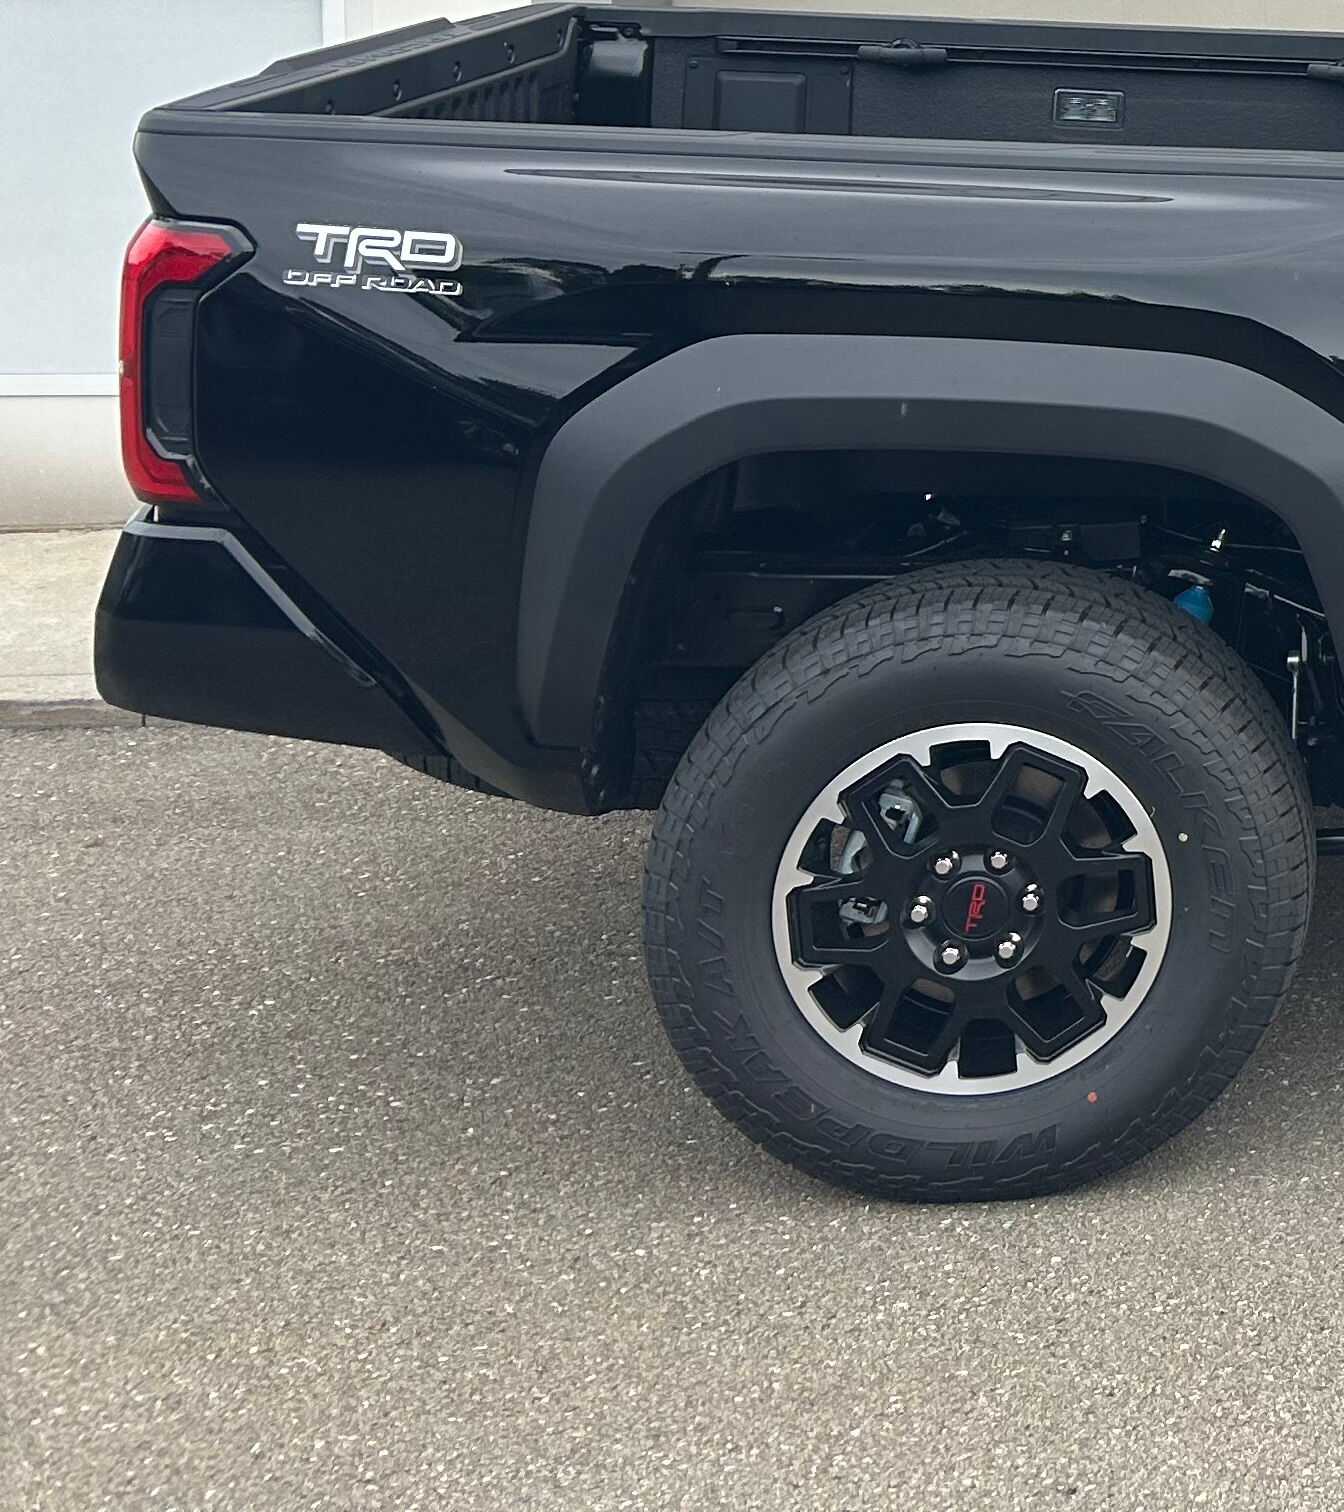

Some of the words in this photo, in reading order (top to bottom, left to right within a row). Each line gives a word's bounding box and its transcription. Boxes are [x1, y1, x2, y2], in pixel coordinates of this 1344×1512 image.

[296, 223, 463, 274] TRD
[283, 269, 357, 288] OFF
[361, 273, 463, 296] ROAD
[1060, 690, 1236, 954] FALKEN
[964, 882, 988, 936] TRD
[712, 1008, 1059, 1170] WILDPEAK
